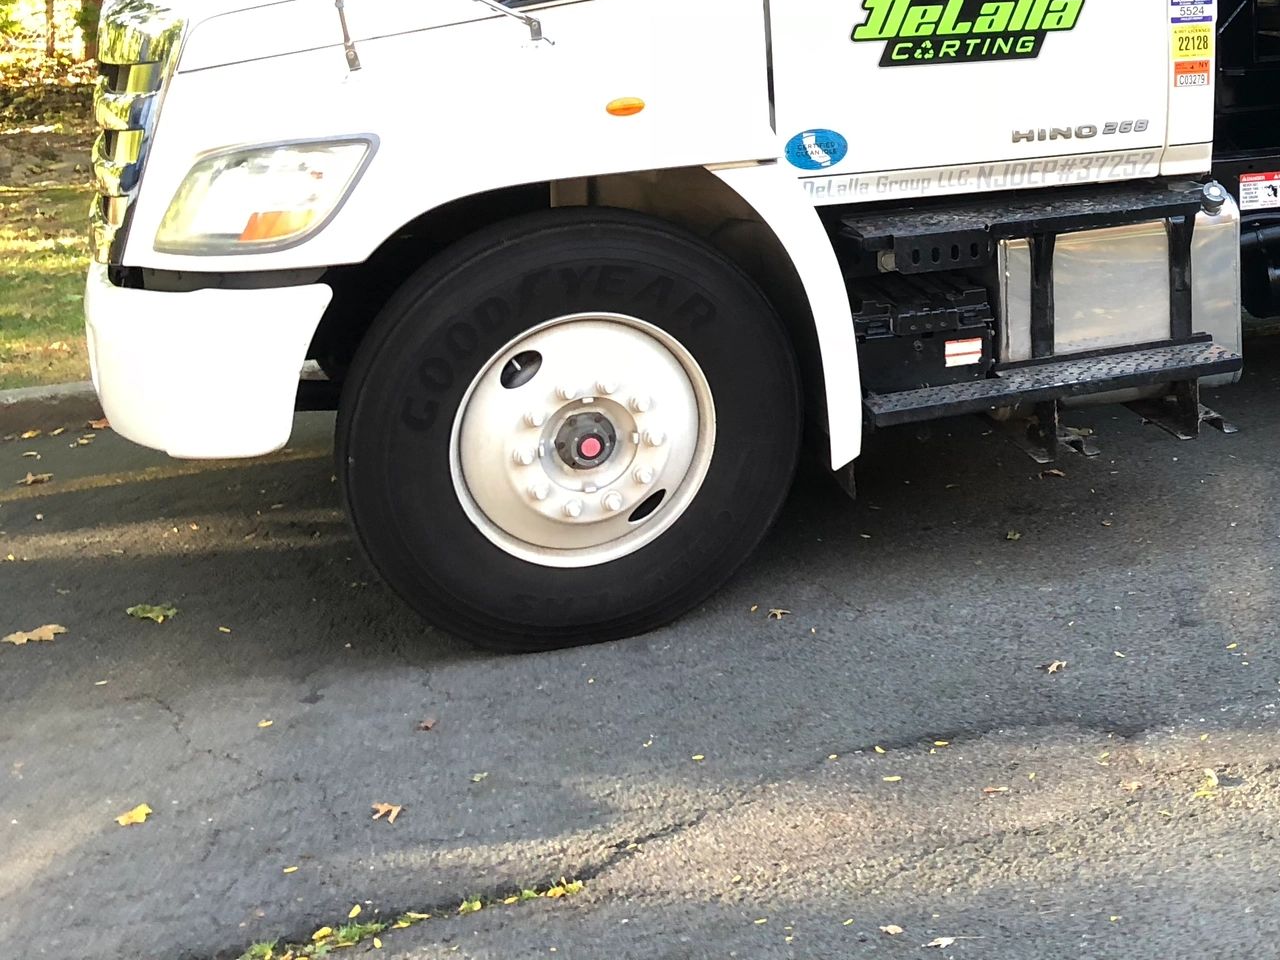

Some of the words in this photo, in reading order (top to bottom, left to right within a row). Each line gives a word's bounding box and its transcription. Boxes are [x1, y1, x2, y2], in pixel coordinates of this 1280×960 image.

[1180, 6, 1204, 16] 5524
[1178, 35, 1208, 51] 22128
[1179, 74, 1205, 85] C03279
[1012, 124, 1097, 143] HINO
[1103, 119, 1149, 135] 268
[875, 174, 931, 195] Group
[975, 151, 1155, 190] NJDEP#37252
[401, 265, 718, 432] GOODYEAR
